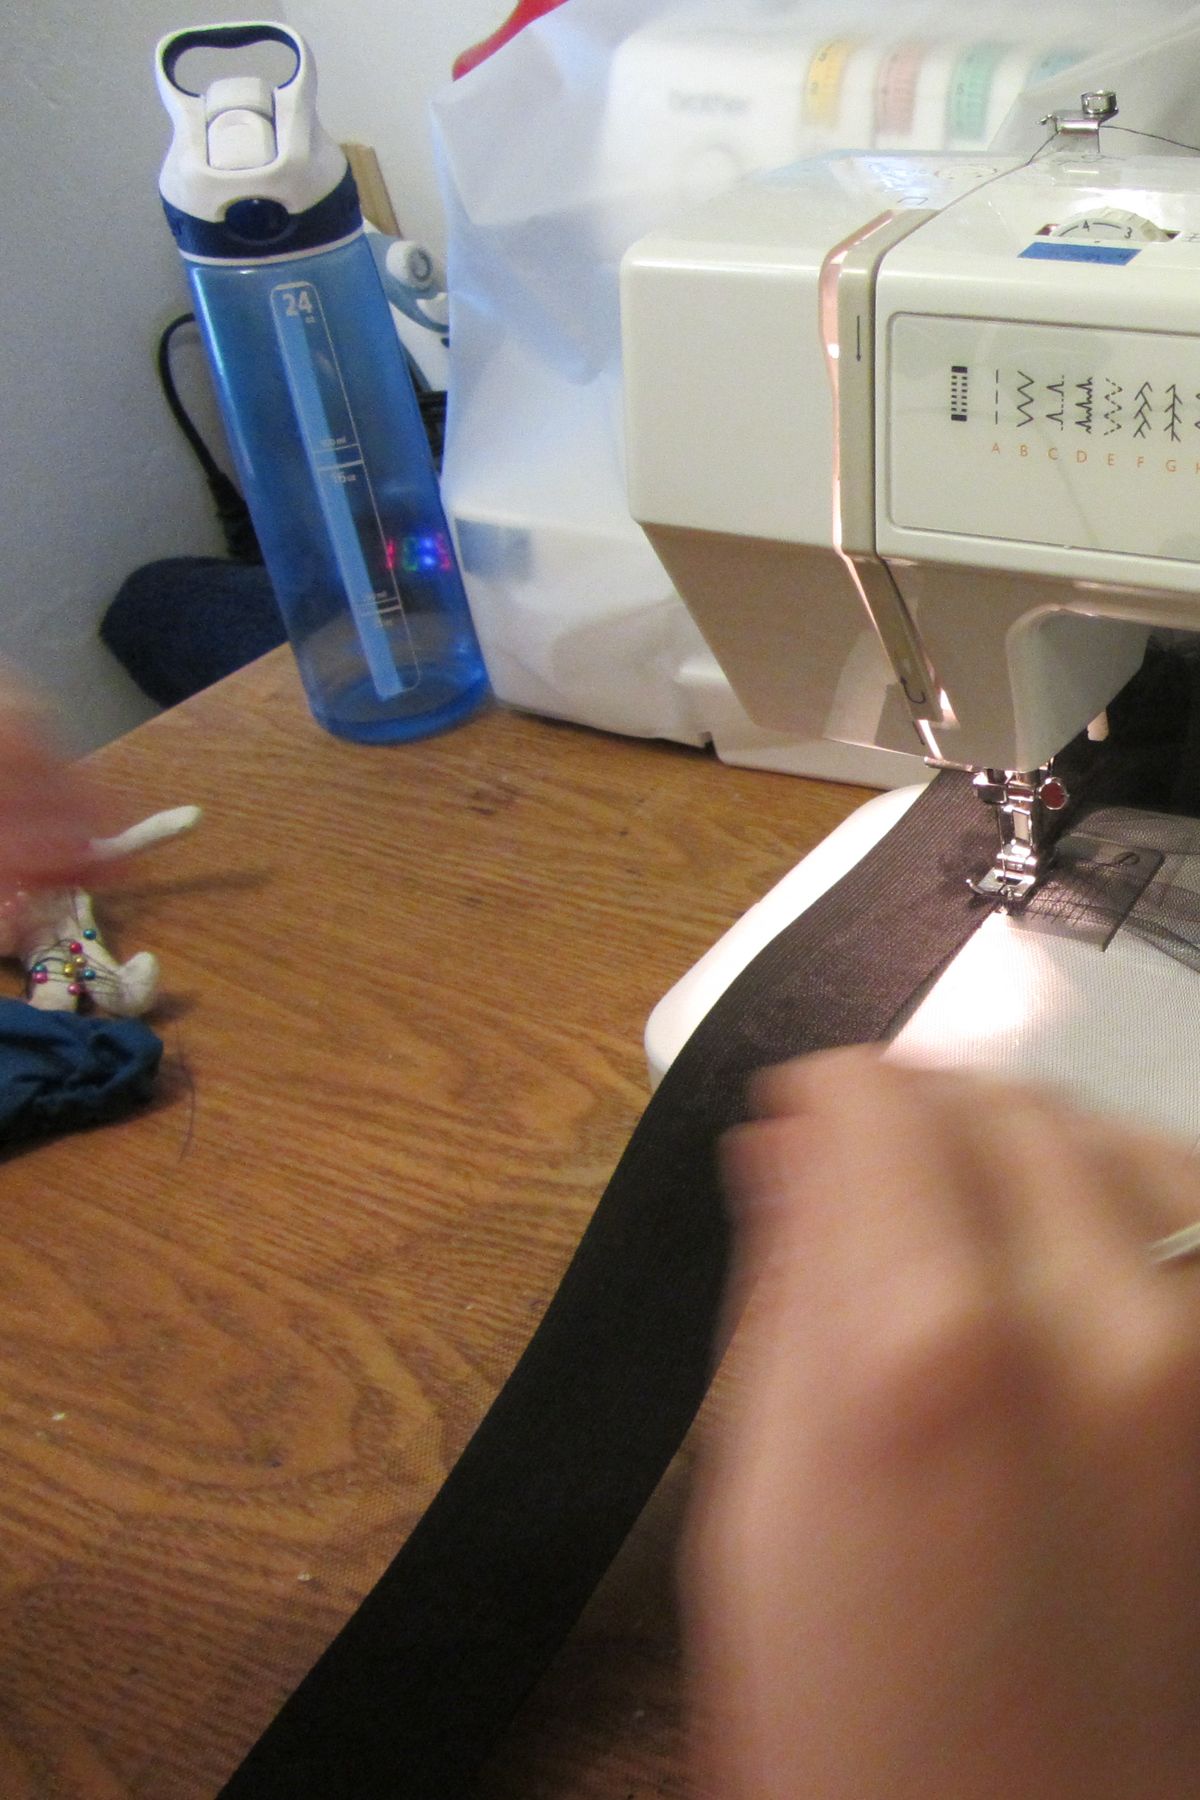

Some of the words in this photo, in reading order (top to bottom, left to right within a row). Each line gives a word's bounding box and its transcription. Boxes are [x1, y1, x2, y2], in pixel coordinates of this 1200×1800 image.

[1082, 219, 1091, 233] 4
[1124, 227, 1133, 240] 3
[282, 291, 312, 316] 24
[992, 442, 1000, 454] A
[1019, 444, 1029, 457] B
[1047, 447, 1058, 461] C
[1076, 450, 1088, 464] D
[1107, 453, 1116, 466] E
[1136, 456, 1144, 468] F
[1165, 459, 1177, 473] G
